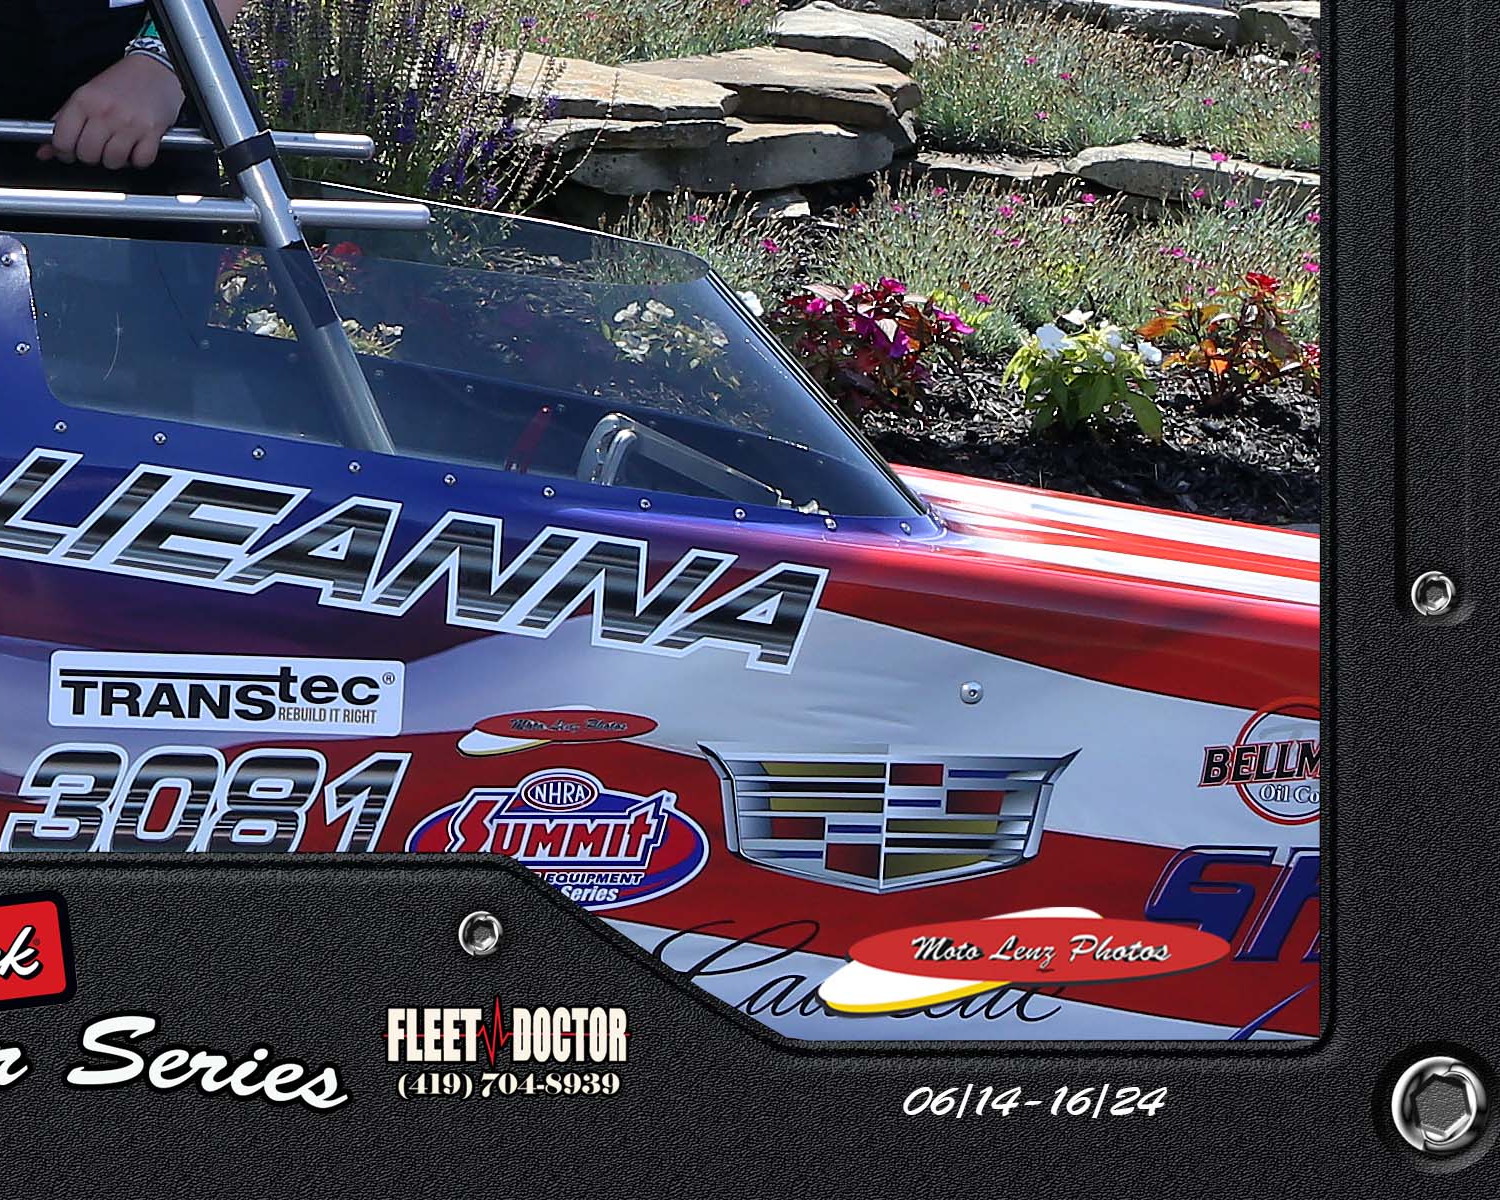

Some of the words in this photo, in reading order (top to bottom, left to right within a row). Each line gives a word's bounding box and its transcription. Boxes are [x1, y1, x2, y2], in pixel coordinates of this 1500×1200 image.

[60, 666, 381, 722] TRANStec
[278, 706, 327, 723] REBUILD
[328, 708, 342, 724] IT
[343, 709, 378, 725] RIGHT
[0, 742, 412, 852] 3081
[533, 780, 587, 803] NHRA
[1259, 783, 1290, 802] Oil
[546, 872, 643, 885] EQUIPMENT
[560, 885, 619, 902] Series
